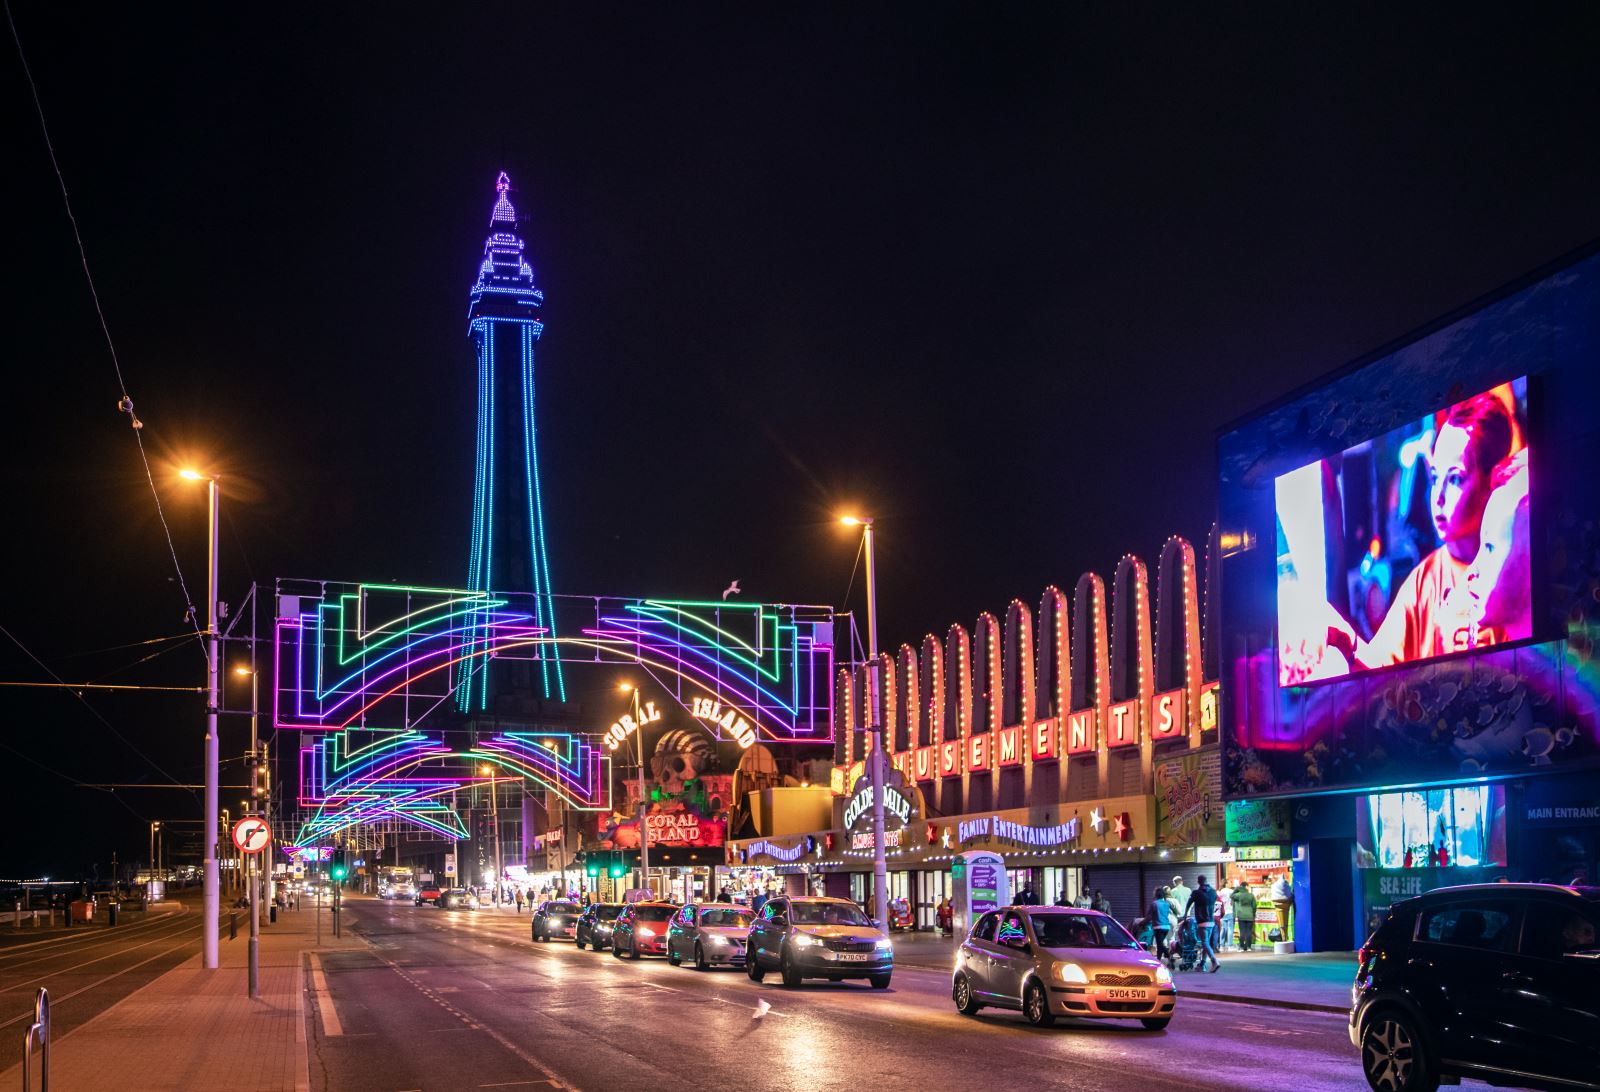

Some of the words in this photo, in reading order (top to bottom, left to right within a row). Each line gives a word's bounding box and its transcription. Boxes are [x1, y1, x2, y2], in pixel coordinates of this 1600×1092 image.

[604, 702, 661, 750] CORAL
[692, 697, 756, 749] ISLAND
[893, 696, 1173, 777] USEMENTS
[844, 785, 874, 830] GOLDE
[882, 785, 910, 824] MILE
[1528, 808, 1552, 820] MAIN
[1555, 806, 1600, 818] ENTRANC
[645, 814, 698, 828] CORAL
[958, 818, 990, 844] FAMILY
[992, 815, 1077, 846] ENTERTAINMENT
[648, 828, 700, 842] SLAND
[852, 830, 899, 850] AMUSENTS
[764, 840, 802, 862] ENTERTAINMENT
[1380, 876, 1400, 895] SEA
[1109, 989, 1129, 998] SV04
